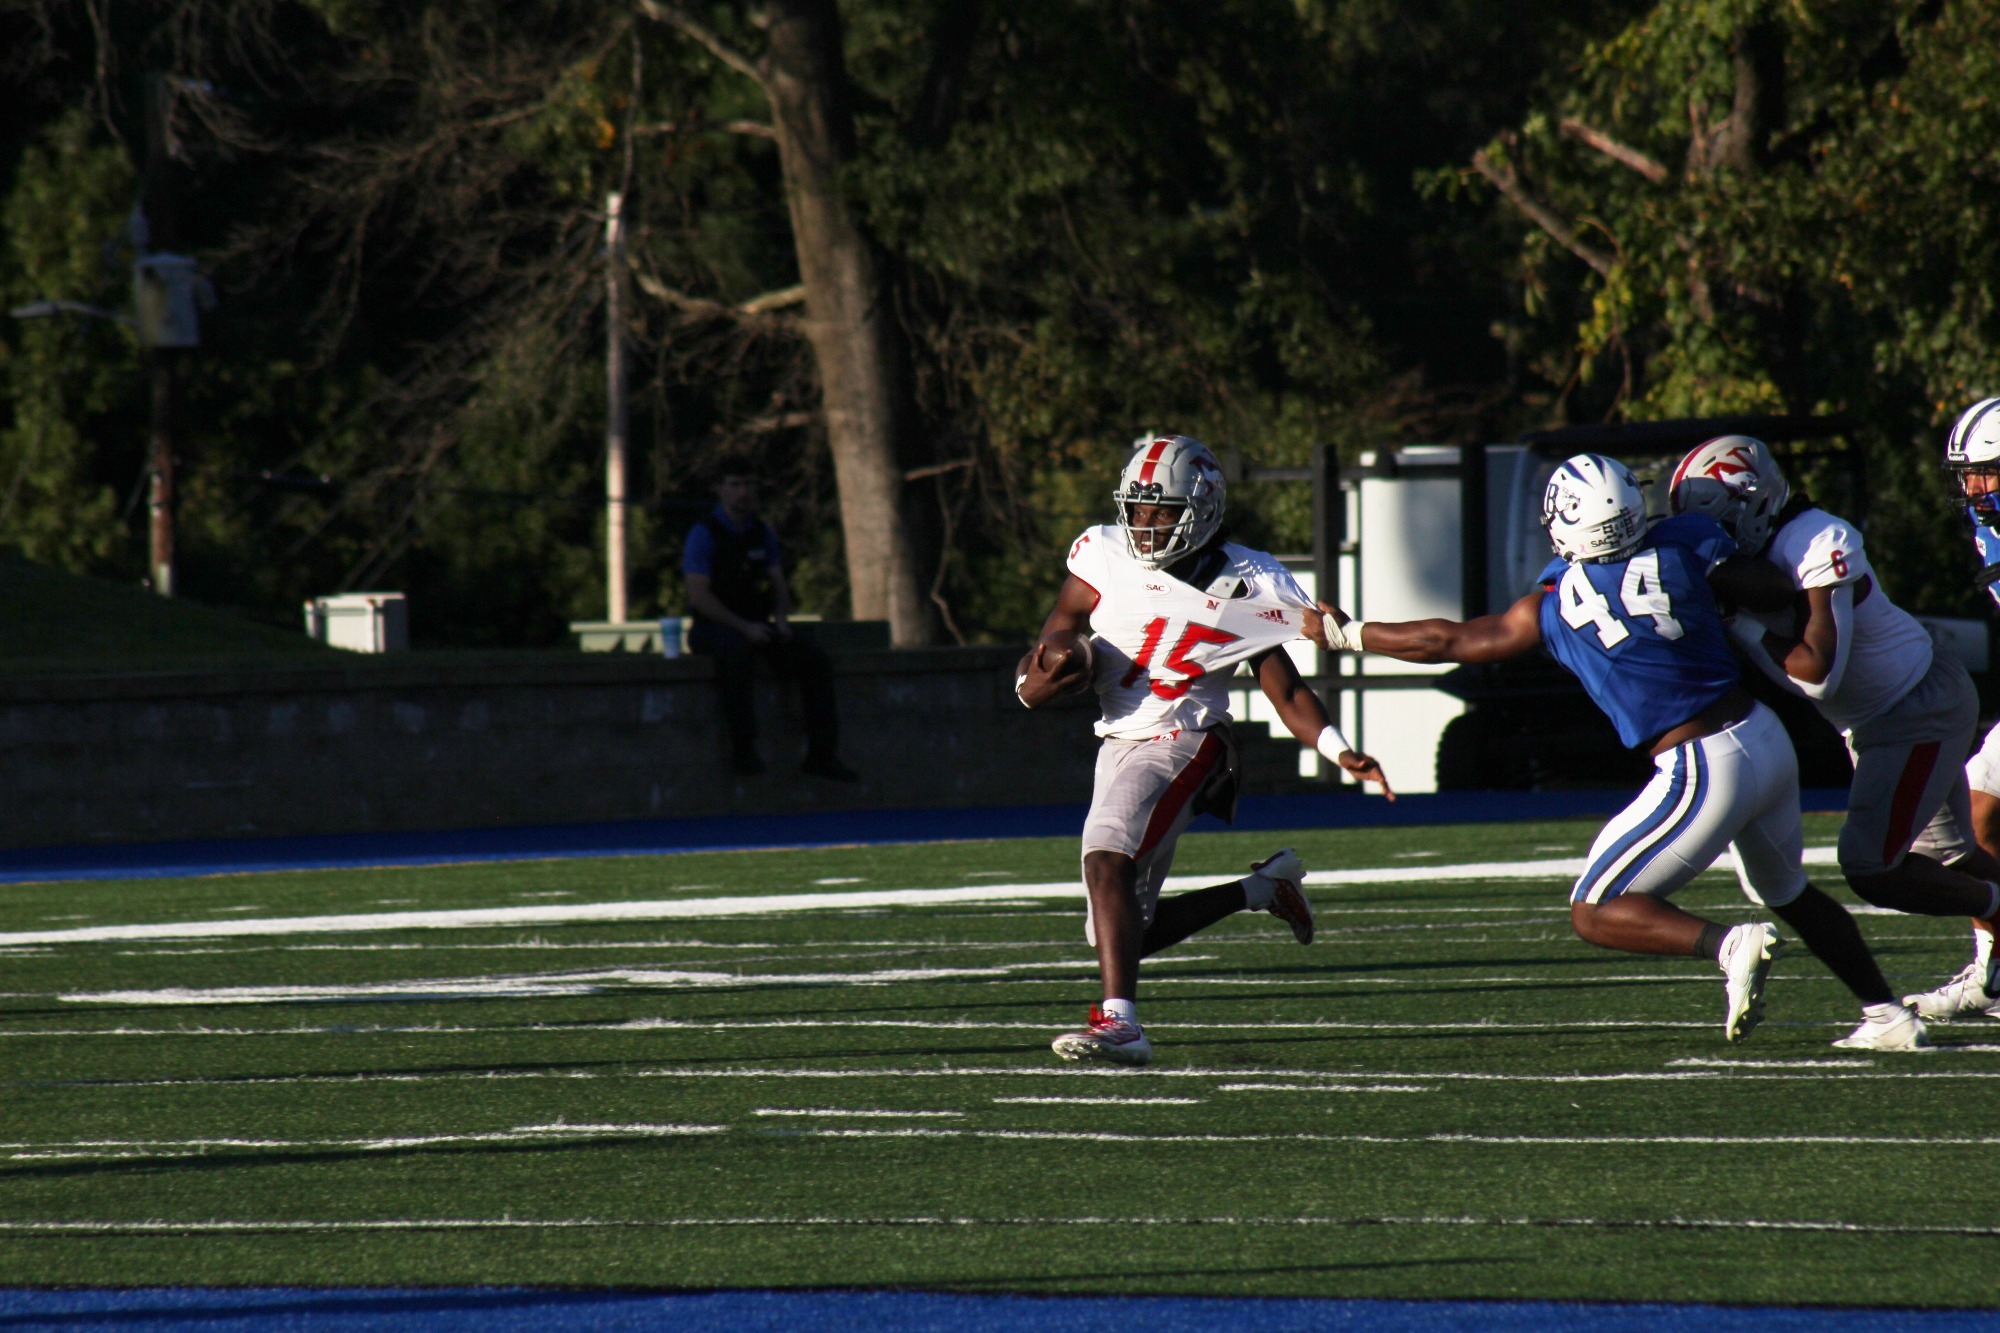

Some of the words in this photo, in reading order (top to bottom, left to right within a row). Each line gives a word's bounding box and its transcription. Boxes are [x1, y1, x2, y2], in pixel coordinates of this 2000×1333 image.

[1590, 537, 1610, 548] SAC
[1830, 549, 1849, 579] 6
[1145, 584, 1165, 592] SAC
[1558, 547, 1685, 650] 44
[1255, 612, 1290, 626] adidas
[1120, 614, 1245, 701] 15
